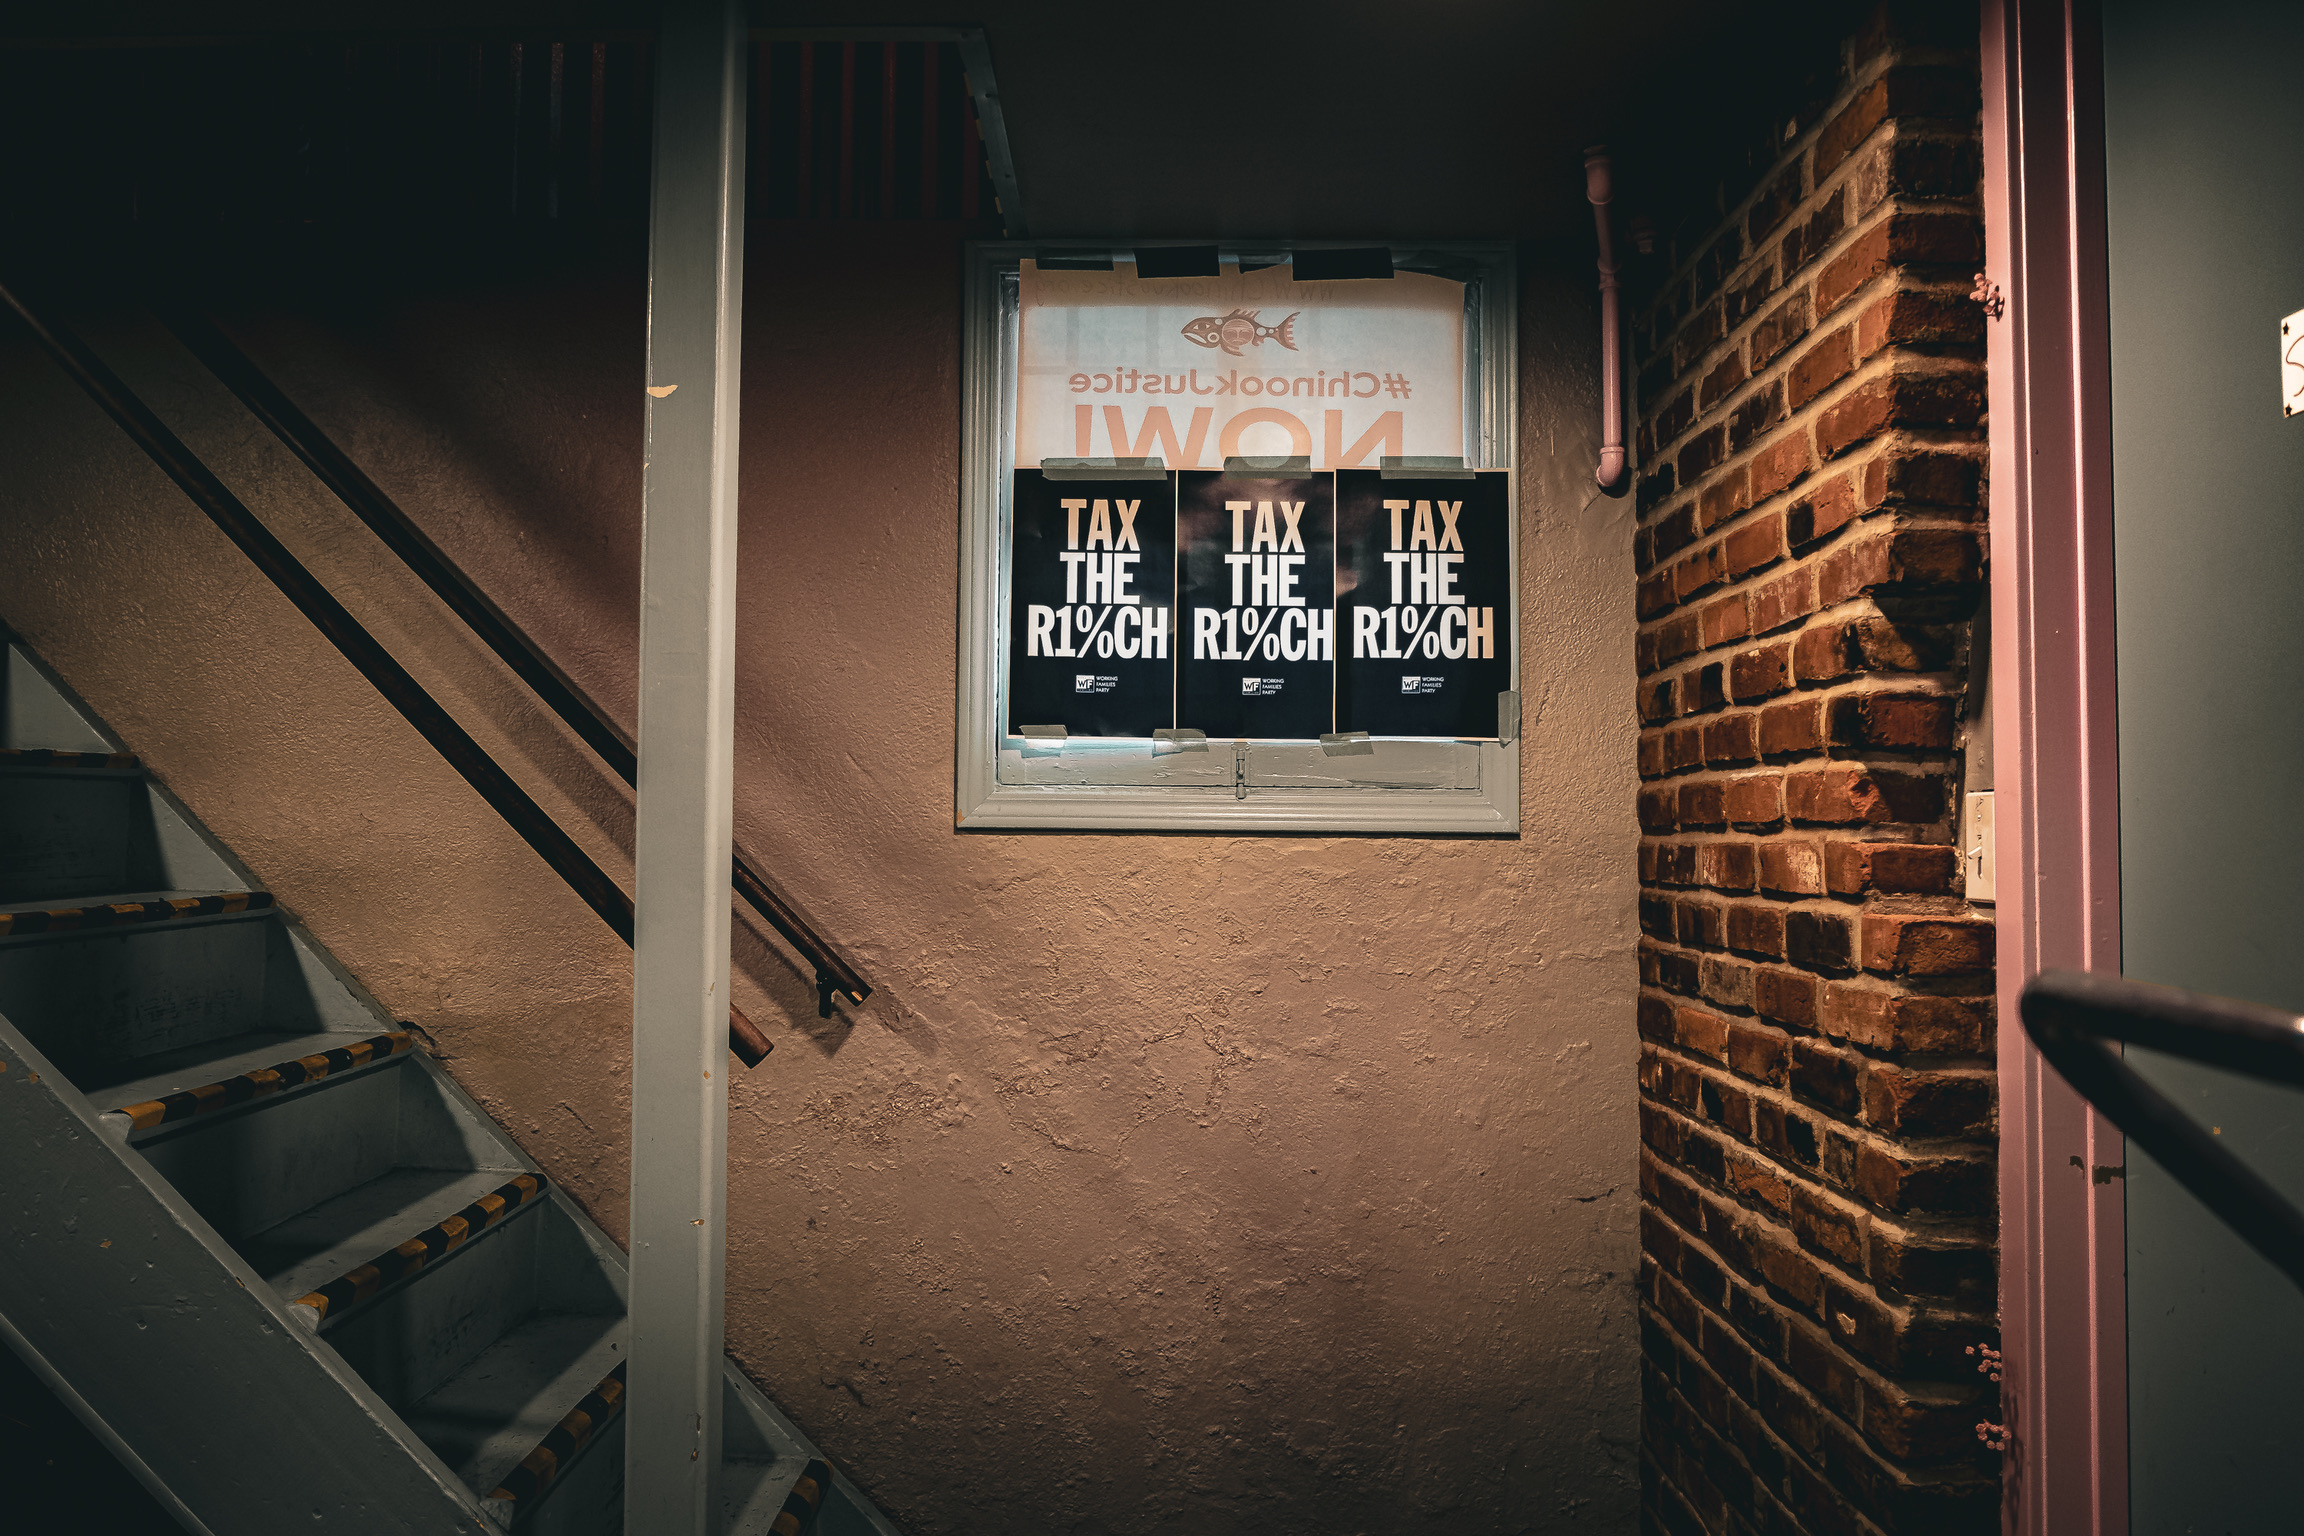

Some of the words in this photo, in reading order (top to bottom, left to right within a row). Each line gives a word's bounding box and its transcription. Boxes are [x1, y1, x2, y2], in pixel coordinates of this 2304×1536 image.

[1060, 498, 1141, 551] TAX
[1225, 500, 1306, 553] TAX
[1383, 499, 1464, 551] TAX
[1059, 552, 1141, 605] THE
[1224, 554, 1306, 606] THE
[1383, 552, 1466, 605] THE
[1027, 605, 1168, 660] R1%CH
[1194, 607, 1334, 662] R1%CH
[1352, 605, 1494, 660] R1%CH
